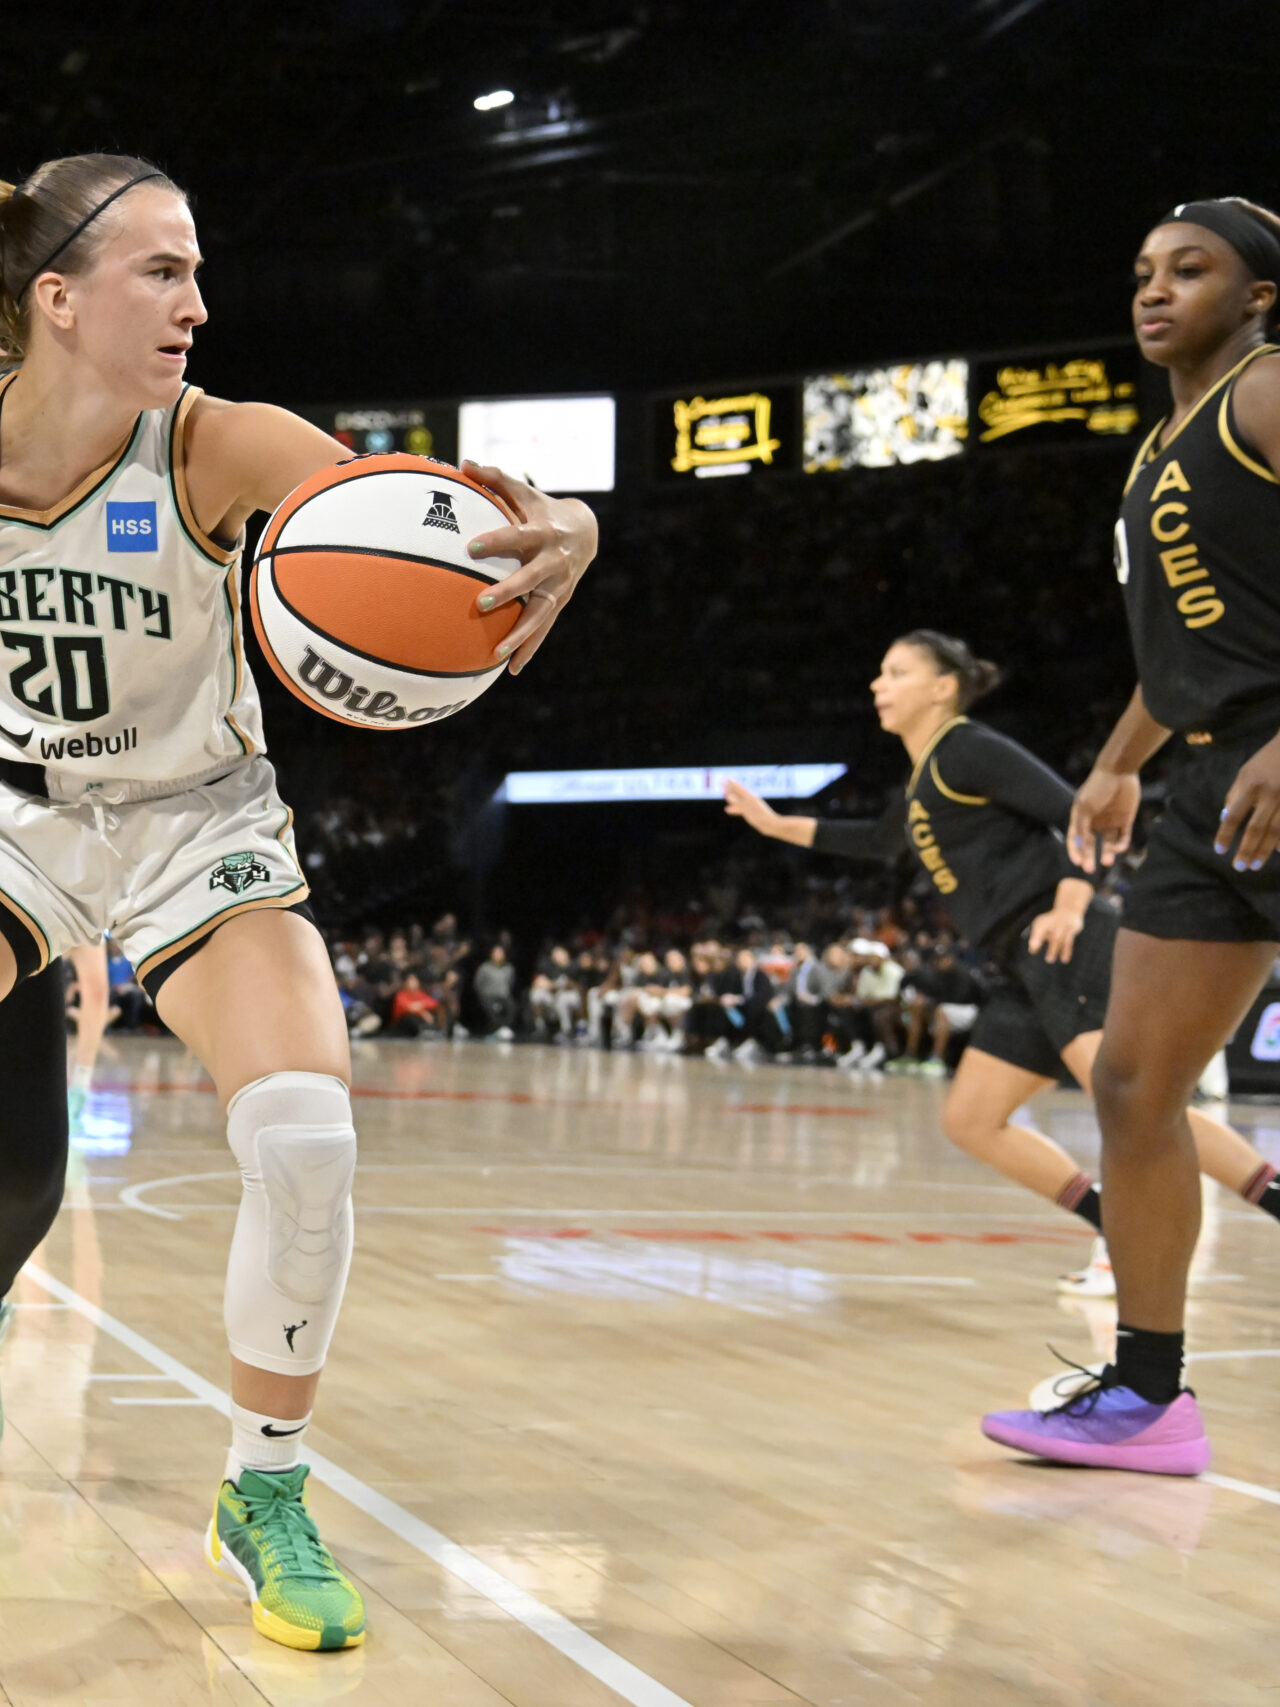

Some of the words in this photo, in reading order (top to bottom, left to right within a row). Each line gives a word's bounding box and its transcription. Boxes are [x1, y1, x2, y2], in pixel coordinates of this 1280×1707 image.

[111, 519, 152, 536] HSS
[1149, 459, 1226, 629] ACES
[0, 628, 111, 723] 20
[296, 643, 468, 723] Wilson
[908, 799, 959, 895] ACES
